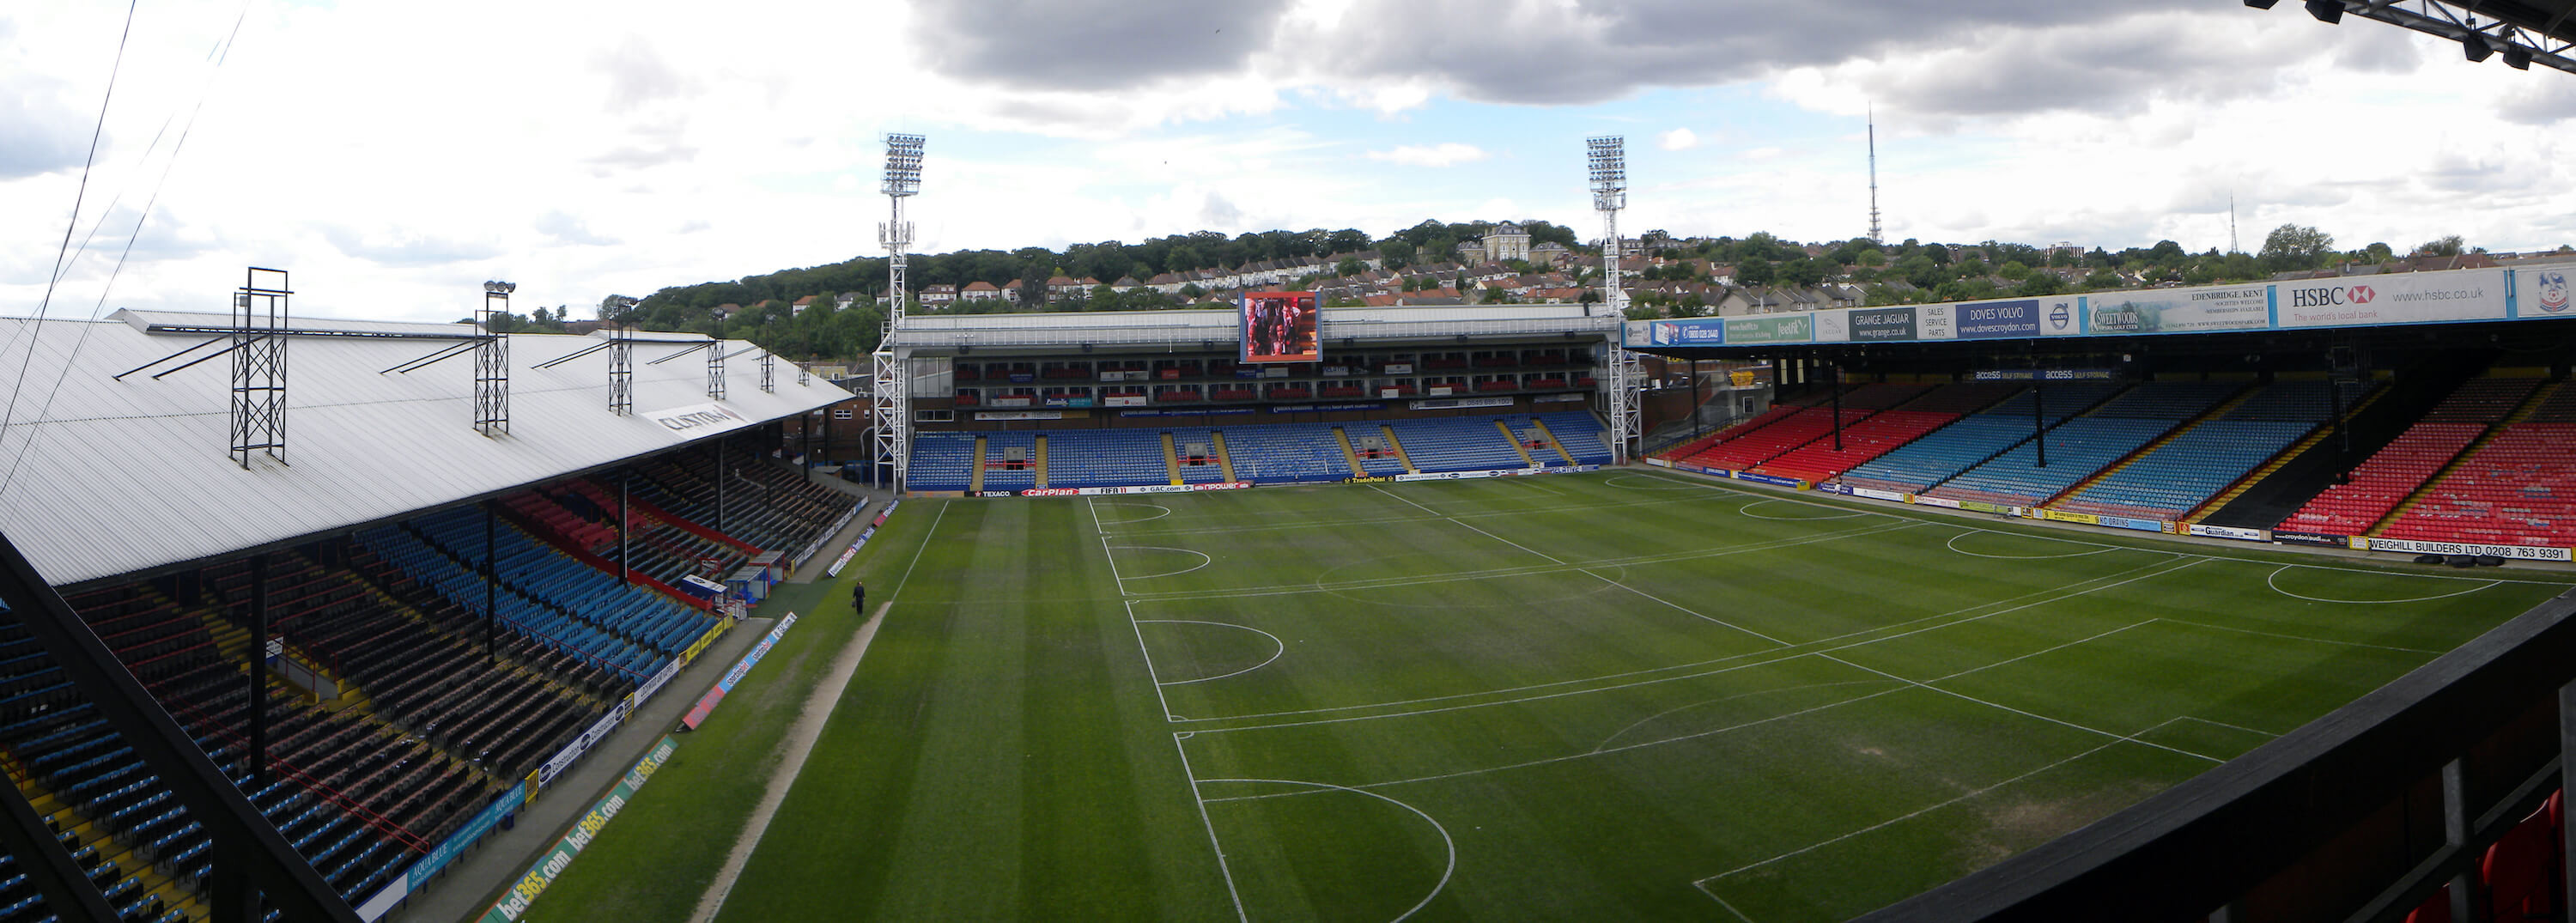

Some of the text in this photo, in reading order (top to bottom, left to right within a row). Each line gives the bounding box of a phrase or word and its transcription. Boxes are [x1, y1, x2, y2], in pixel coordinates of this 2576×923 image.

[2244, 289, 2263, 298] KENT
[2292, 286, 2345, 307] HSBC
[2392, 286, 2484, 303] www.hsbc.co.uk
[1928, 308, 1944, 317] SALES
[1971, 307, 2024, 320] DOVES VOLVO
[2097, 311, 2139, 325] SWEETWOODS
[2293, 310, 2378, 322] The world's local bank
[1855, 313, 1910, 326] GRANGE JAGUAR
[1925, 318, 1947, 327] SERVICE
[1859, 327, 1907, 338] www.grange.co.uk
[1929, 328, 1945, 337] PARTS
[1960, 322, 2036, 334] www.dovescroydon.com
[1976, 371, 2001, 380] access
[2045, 370, 2073, 379] access
[1028, 488, 1073, 496] CarPlan
[2204, 526, 2234, 537] Guardian
[2370, 538, 2413, 551] WEIGHILL
[2415, 542, 2462, 554] BUILDERS
[2464, 544, 2482, 556] LTD
[2486, 547, 2512, 556] 0208
[2517, 547, 2536, 557] 763
[2539, 548, 2565, 559] 9391
[591, 716, 615, 741] Construction
[552, 745, 580, 774] Construction
[623, 744, 673, 792] bet365.com
[495, 784, 523, 814] AQUA BLUE
[565, 794, 625, 853] bet365.com
[412, 842, 448, 879] AQUA BLUE
[496, 849, 572, 921] bet365.com
